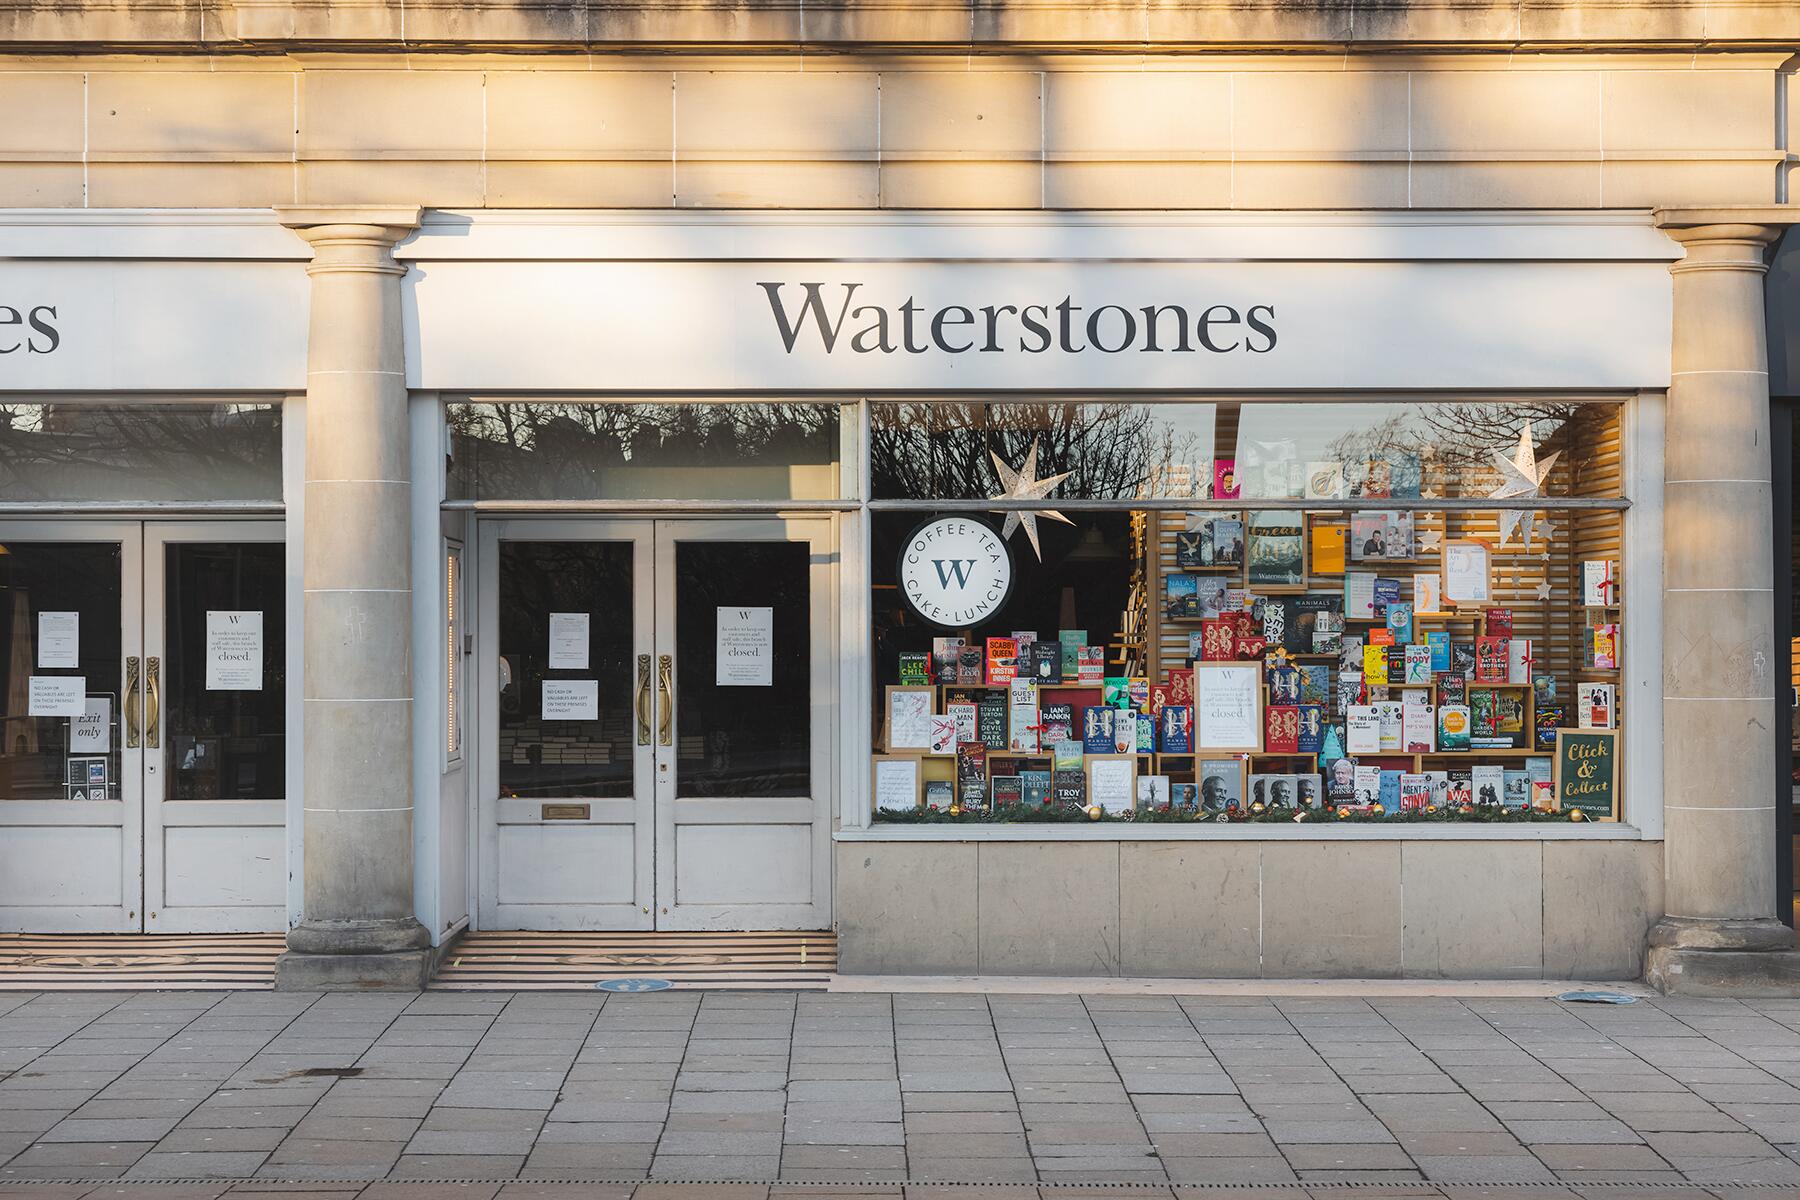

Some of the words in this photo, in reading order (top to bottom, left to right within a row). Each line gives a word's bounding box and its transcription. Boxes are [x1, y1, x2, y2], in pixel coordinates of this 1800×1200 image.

[756, 281, 1278, 354] Waterstones
[908, 523, 966, 564] COFFEE
[978, 533, 1001, 563] TEA
[930, 559, 978, 590] W
[907, 579, 941, 618] CAKE
[954, 578, 1004, 622] LUNCH
[228, 616, 241, 624] W
[740, 611, 752, 619] W
[728, 647, 760, 656] closed.
[990, 641, 1015, 649] SCABBY
[218, 652, 252, 660] closed.
[1221, 670, 1234, 679] W
[78, 713, 100, 723] Exit
[1212, 708, 1246, 718] closed.
[78, 726, 100, 739] only
[1568, 740, 1608, 761] Click
[1577, 760, 1597, 778] &
[1452, 790, 1470, 800] WA
[1565, 782, 1608, 796] Collect
